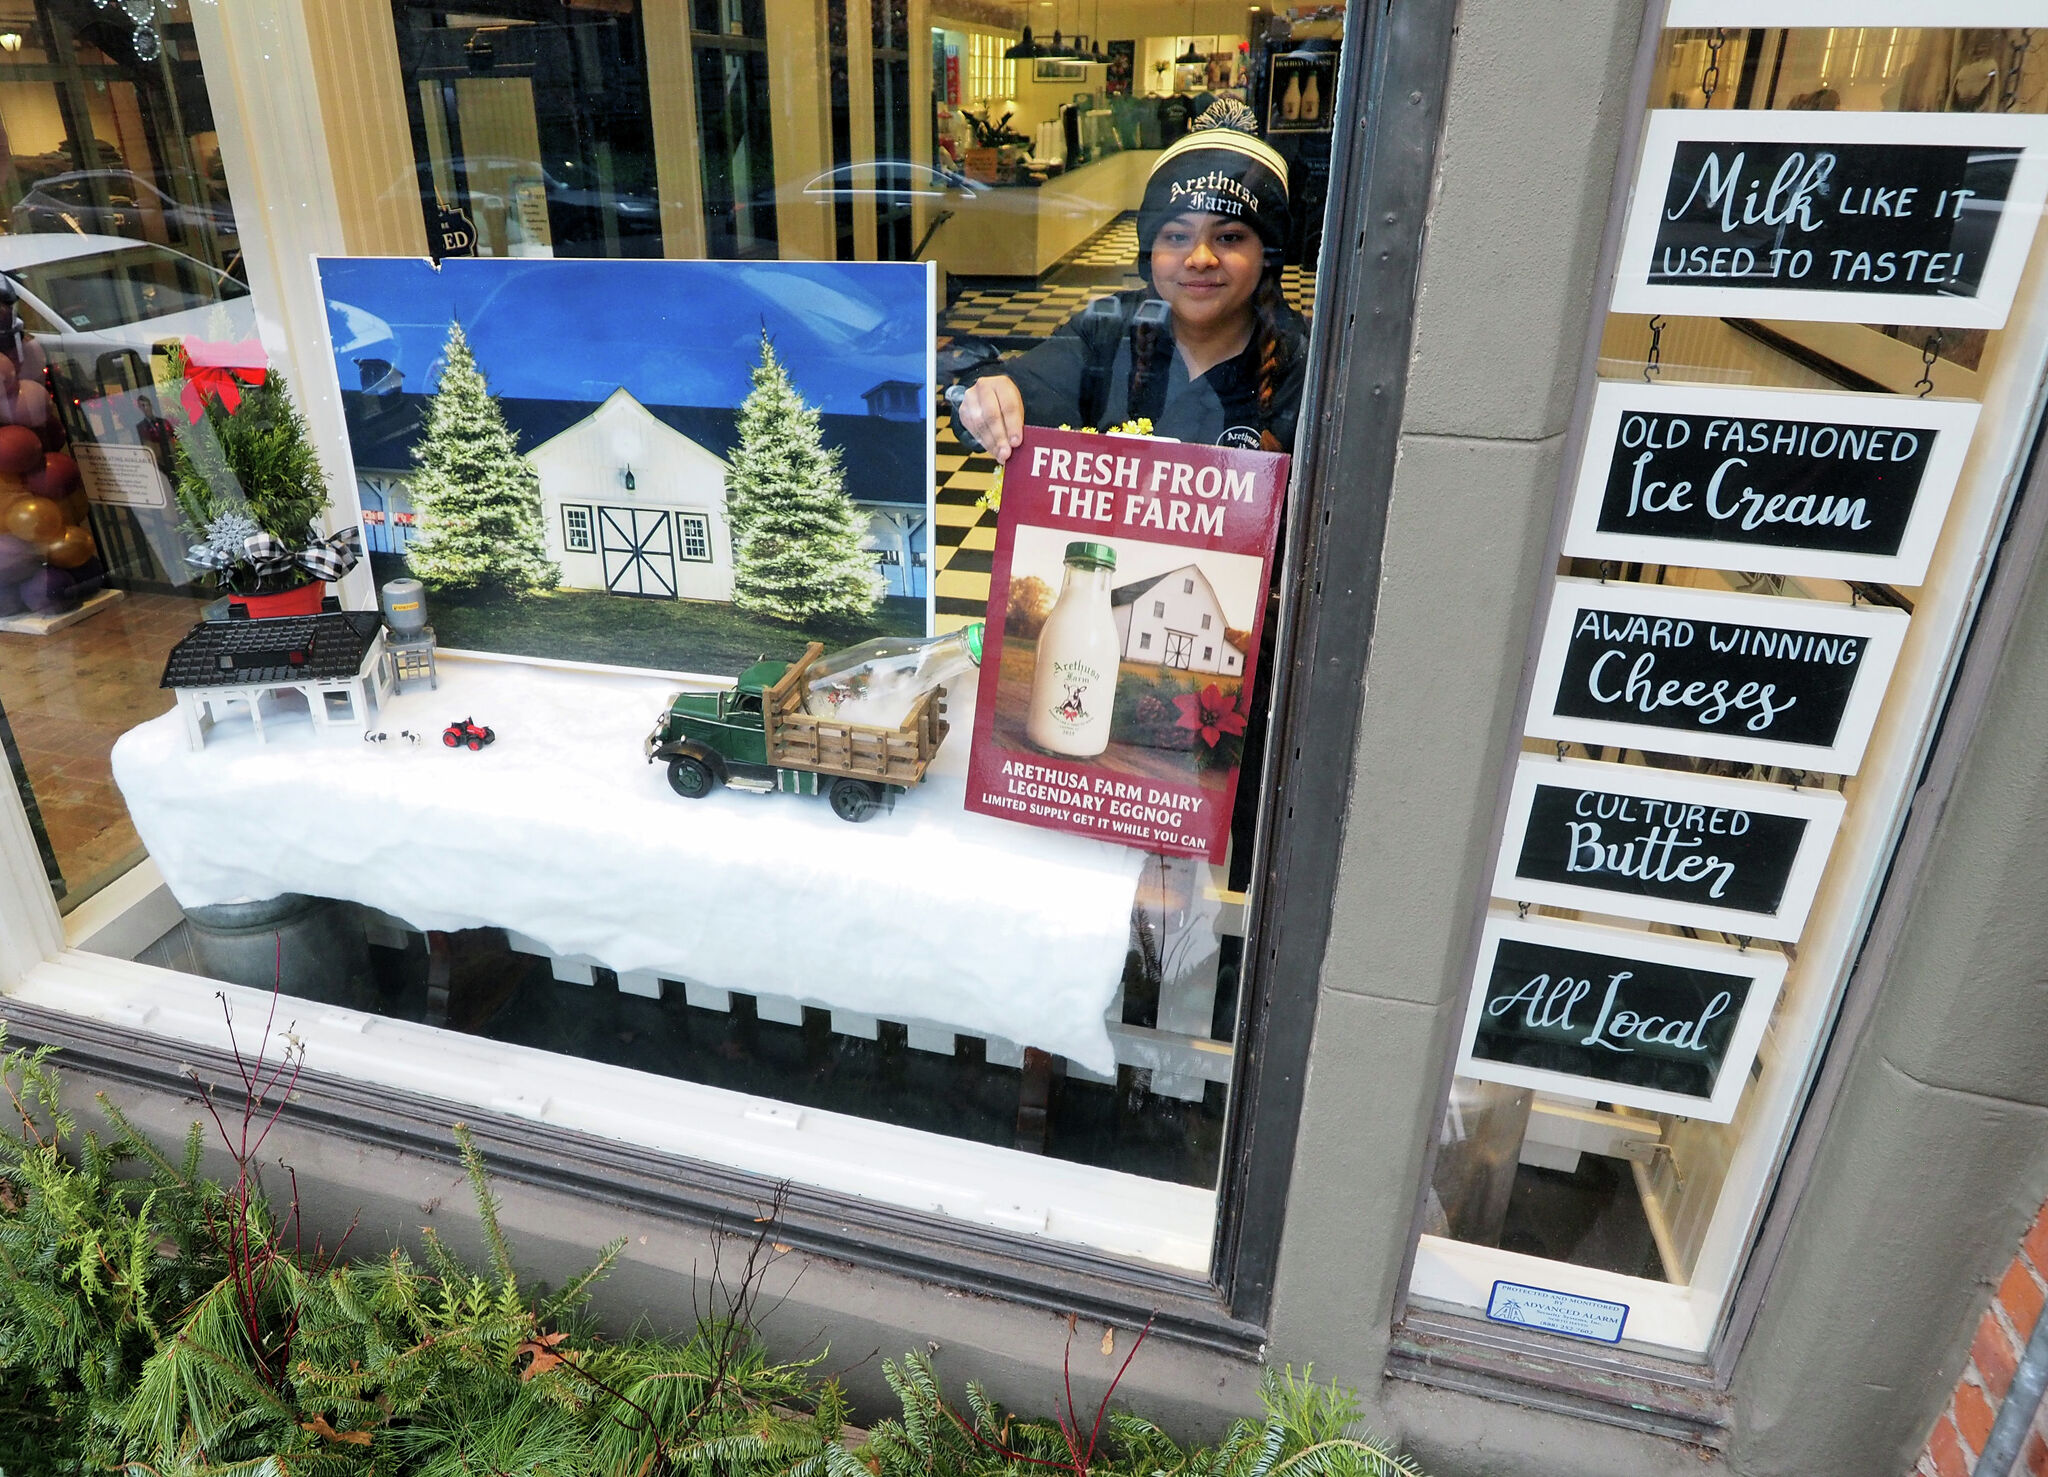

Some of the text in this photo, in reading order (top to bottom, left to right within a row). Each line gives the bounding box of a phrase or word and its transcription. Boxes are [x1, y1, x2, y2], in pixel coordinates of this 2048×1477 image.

[1169, 170, 1259, 212] Arethusa
[1187, 191, 1243, 215] Farm
[1667, 151, 1976, 232] Milk LIKE IT
[443, 232, 469, 250] ED
[1663, 246, 1964, 284] USED TO TASTE!
[1622, 415, 1919, 461] OLD FASHIONED
[1031, 447, 1256, 503] FRESH FROM
[1626, 451, 1872, 531] Ice Cream
[1048, 484, 1226, 537] THE FARM
[1576, 611, 1858, 665] AWARD WINNING
[1053, 660, 1100, 681] Arethusa
[1588, 650, 1797, 731] Cheeses
[1002, 760, 1203, 813] ARETHUSA FARM DAIRY
[1008, 779, 1182, 828] LEGENDARY EGGNOG
[982, 793, 1207, 849] LIMITED SUPPLY GET IT WHILE YOU CAN
[1575, 791, 1750, 836] CULTURED
[1565, 821, 1736, 898] Butter
[1489, 971, 1731, 1052] All Local
[1502, 1285, 1549, 1297] PROTECTED
[1570, 1299, 1620, 1312] MONITORED
[1523, 1301, 1618, 1324] ADVANCED ALARM
